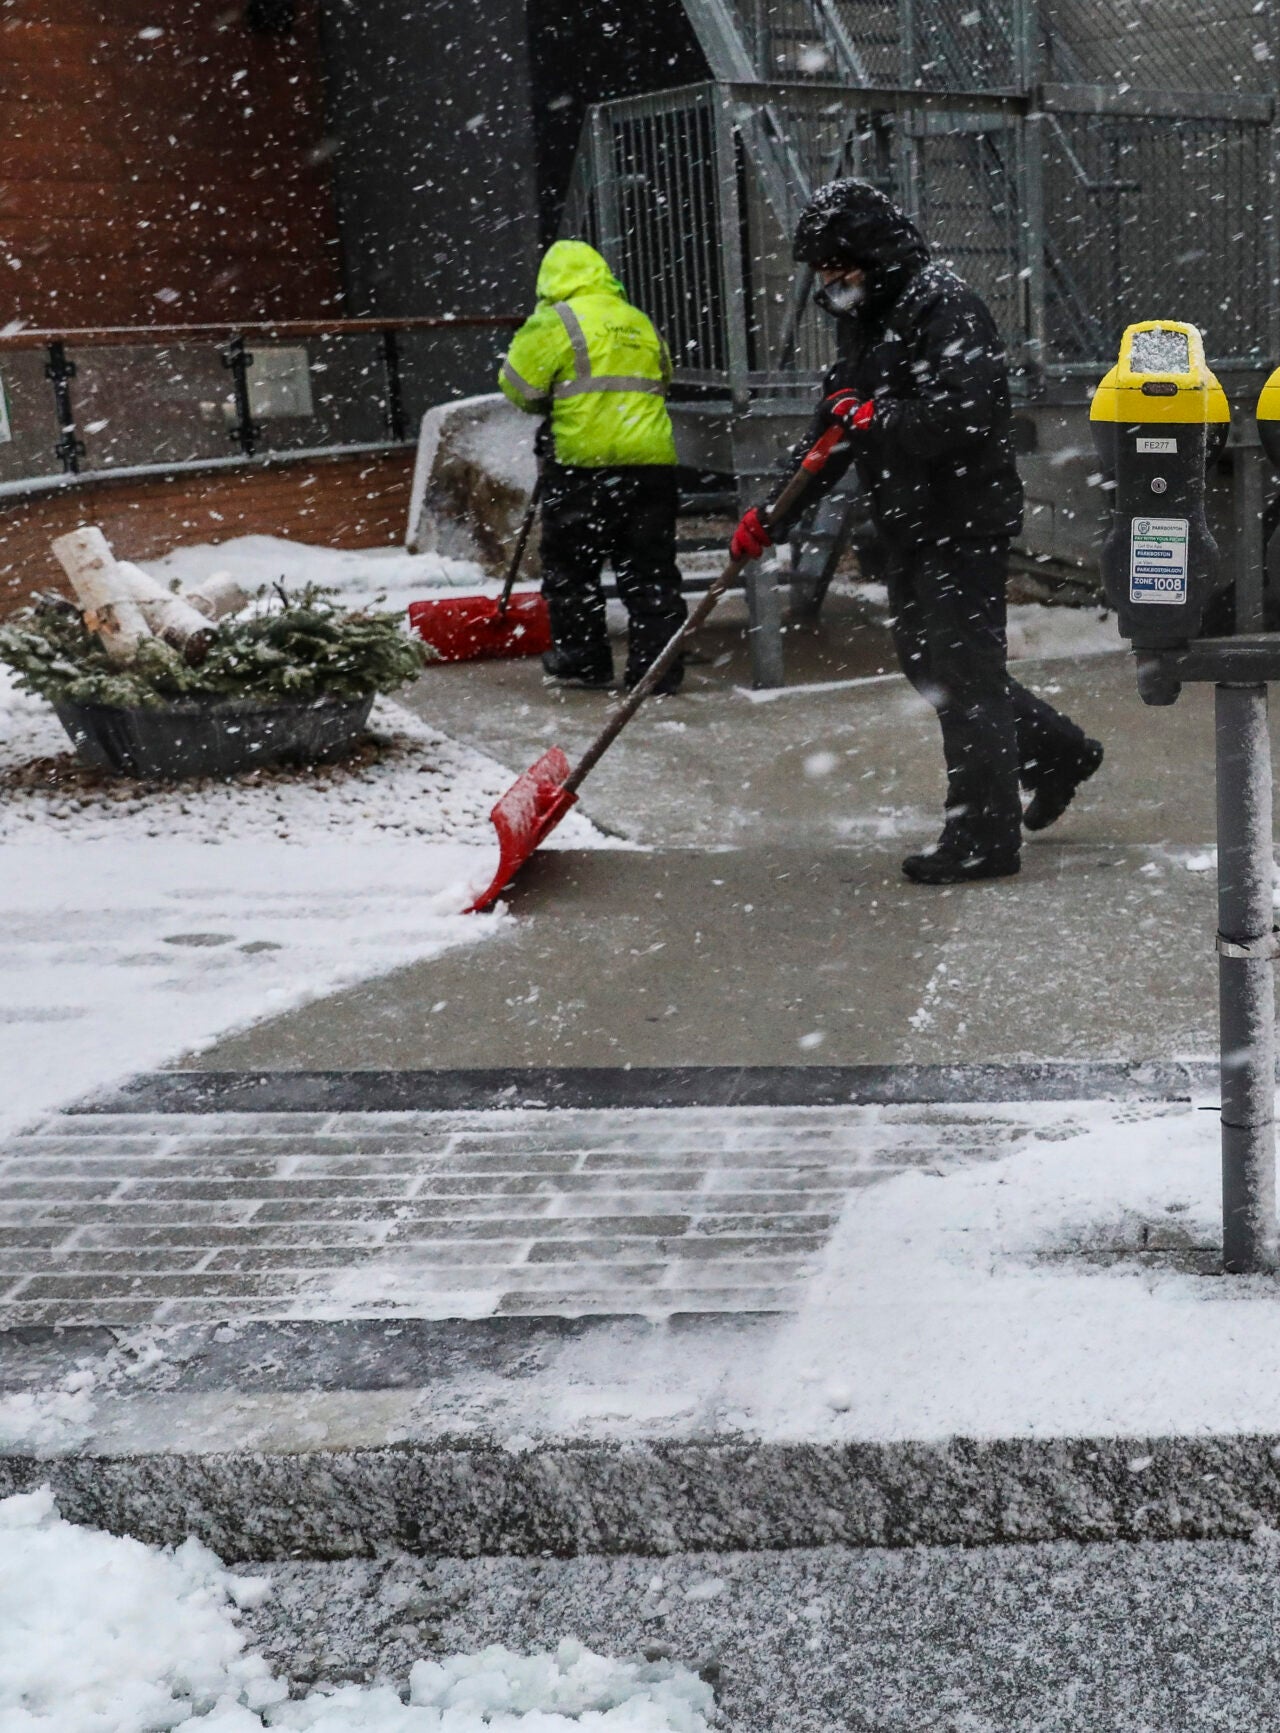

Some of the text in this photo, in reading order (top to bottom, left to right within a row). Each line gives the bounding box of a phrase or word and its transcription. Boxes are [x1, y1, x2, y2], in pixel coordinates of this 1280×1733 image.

[1144, 441, 1169, 449] FE277
[1134, 577, 1182, 590] ZONE 1008
